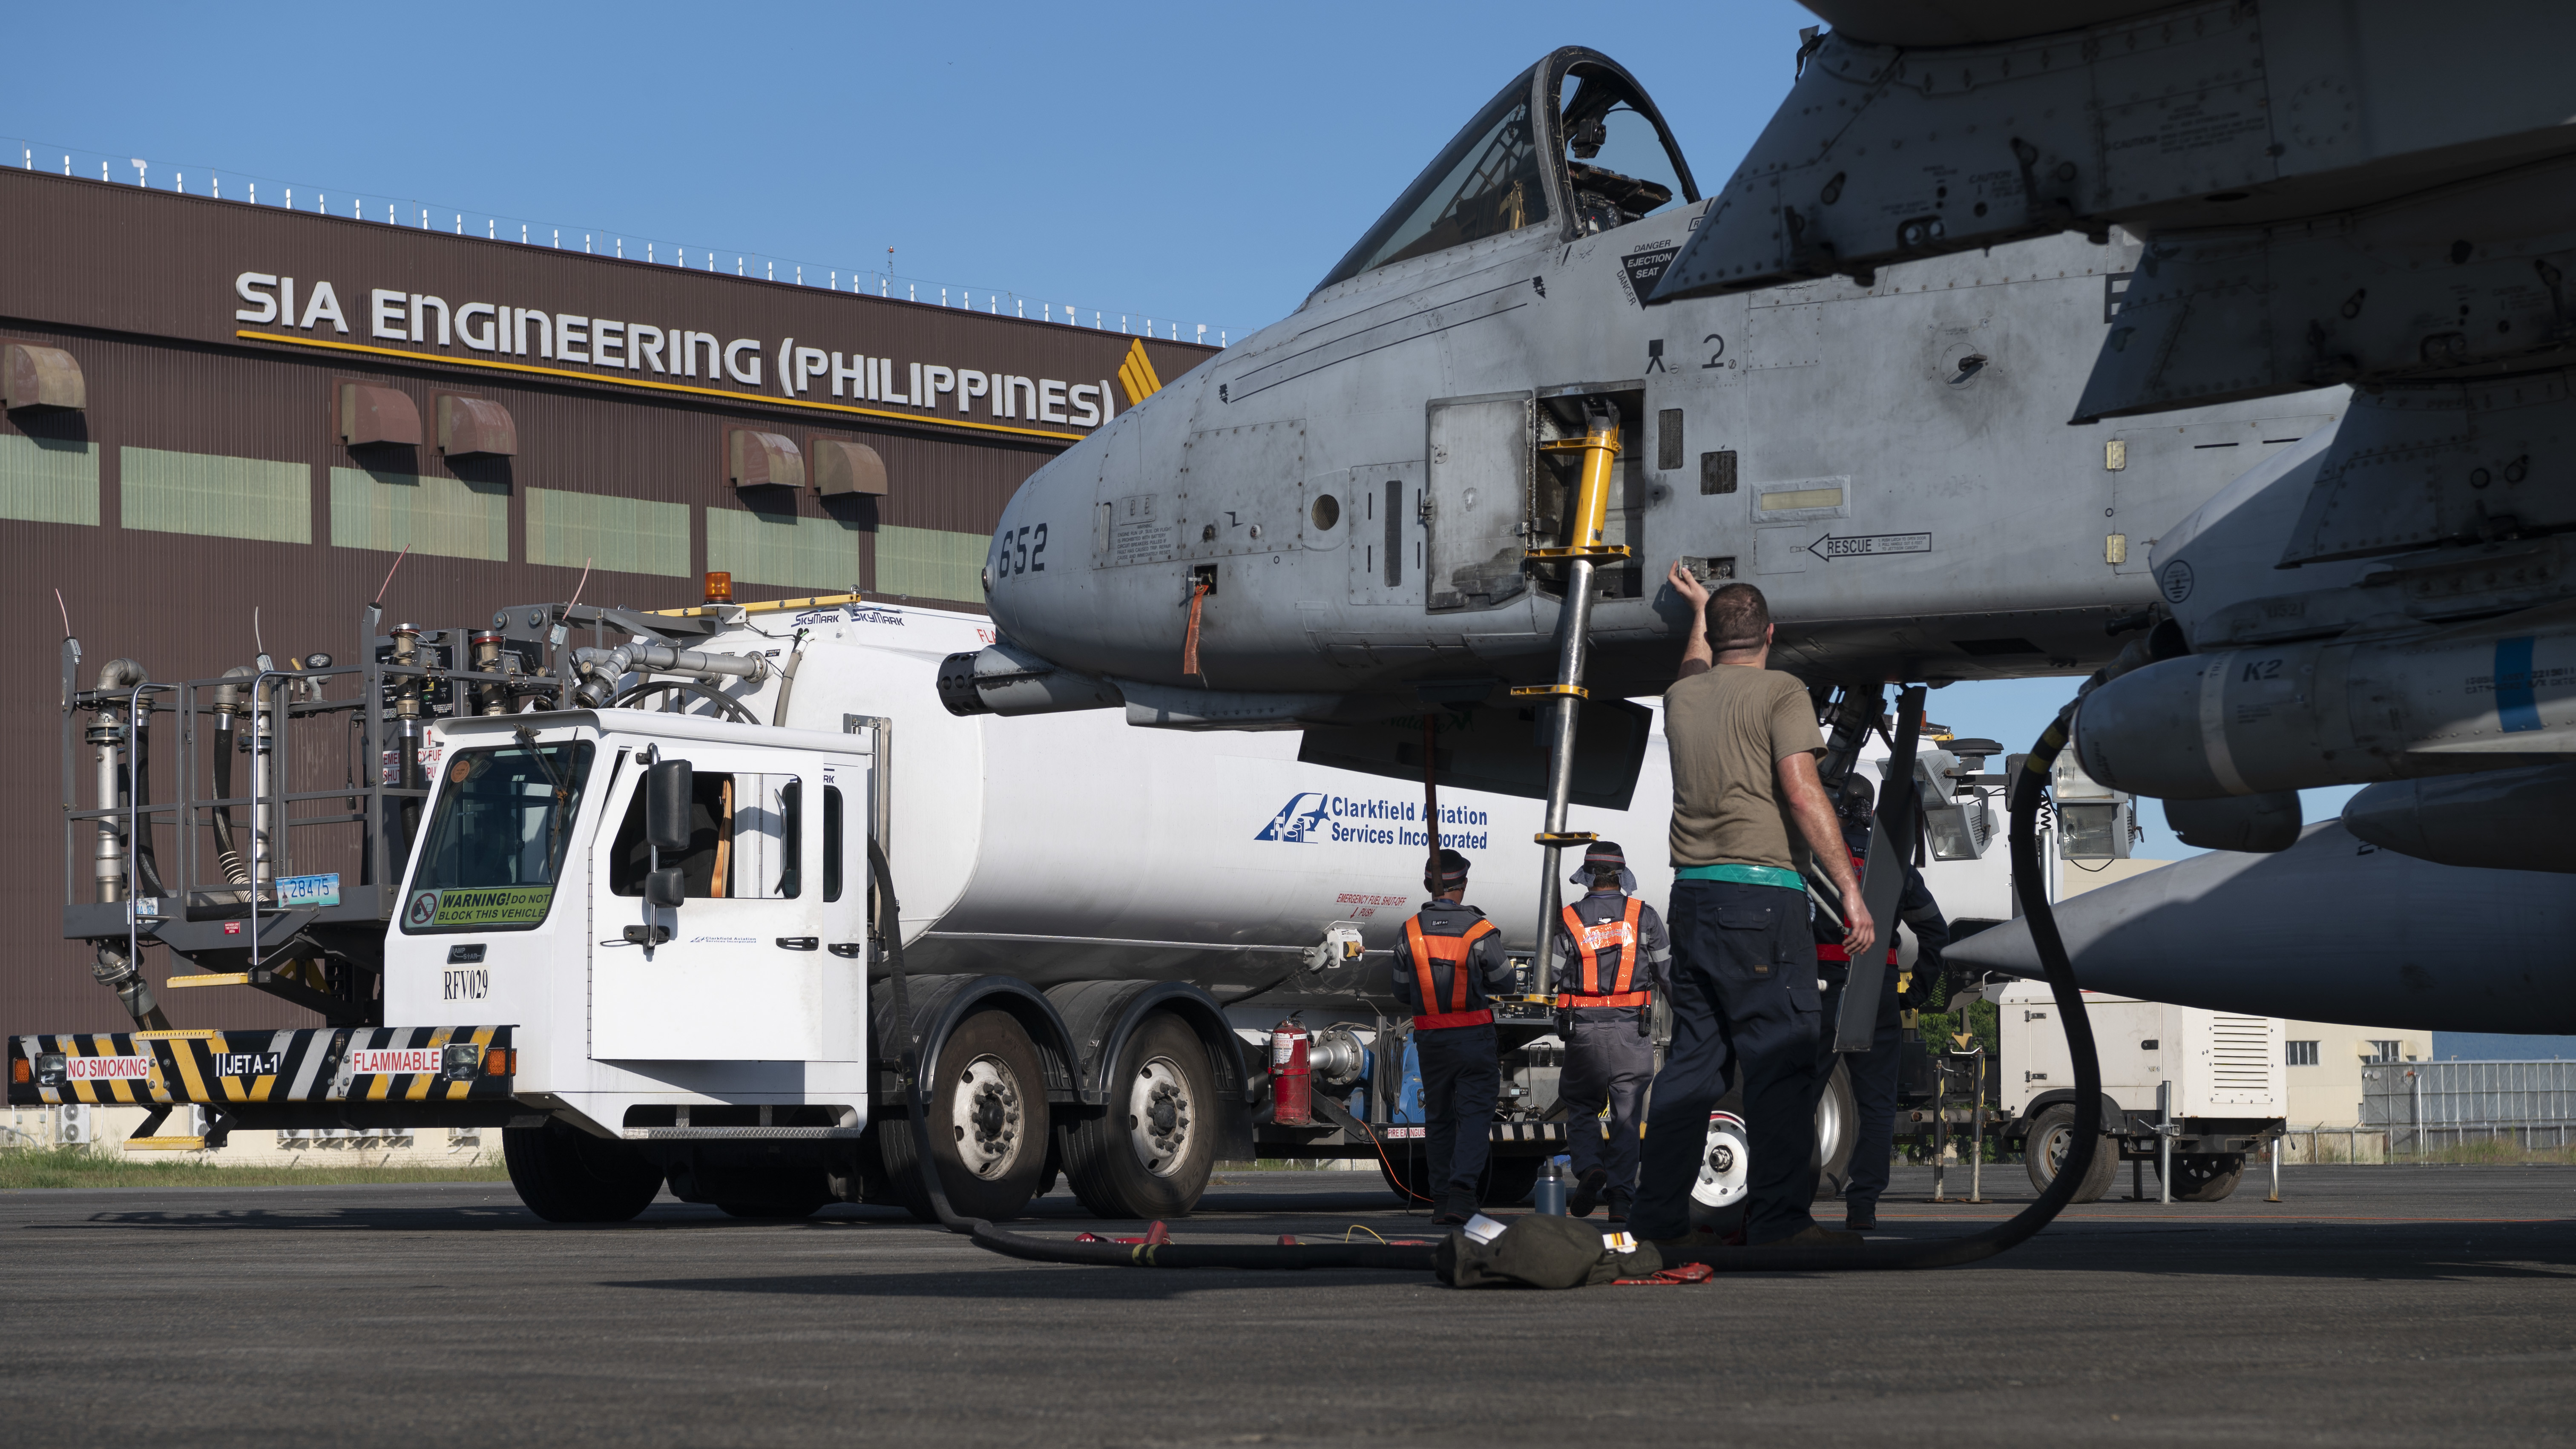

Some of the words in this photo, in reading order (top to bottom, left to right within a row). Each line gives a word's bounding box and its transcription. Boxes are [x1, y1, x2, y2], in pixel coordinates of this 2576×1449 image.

[1634, 239, 1671, 253] DANGER
[1627, 253, 1672, 267] EJECTION
[1636, 267, 1659, 279] SEAT
[1617, 270, 1636, 306] DANGER
[236, 272, 349, 332] SIA
[999, 523, 1048, 578] 652
[1828, 539, 1872, 554] RESCUE
[2242, 659, 2283, 682] K2
[384, 750, 426, 766] EMECY
[428, 750, 442, 761] FUE
[1332, 796, 1415, 821] Clarkfield
[1332, 822, 1394, 845] Services
[1399, 826, 1487, 849] Incoorated
[290, 878, 329, 898] 28475
[442, 893, 511, 908] WARNING!
[511, 895, 526, 904] DO
[528, 894, 550, 903] NOT
[1336, 893, 1369, 905] EMERGENCY
[1369, 896, 1381, 906] FUEL
[1382, 897, 1407, 906] SHUT-OFF
[438, 911, 472, 920] BLOCK
[476, 909, 498, 918] THIS
[502, 908, 545, 918] VEHICLE
[1358, 908, 1375, 917] PUSH
[444, 969, 488, 1000] RFV029
[68, 1060, 86, 1078] NO
[89, 1058, 147, 1077] SMOKING
[354, 1051, 440, 1072] FLAMMABLE
